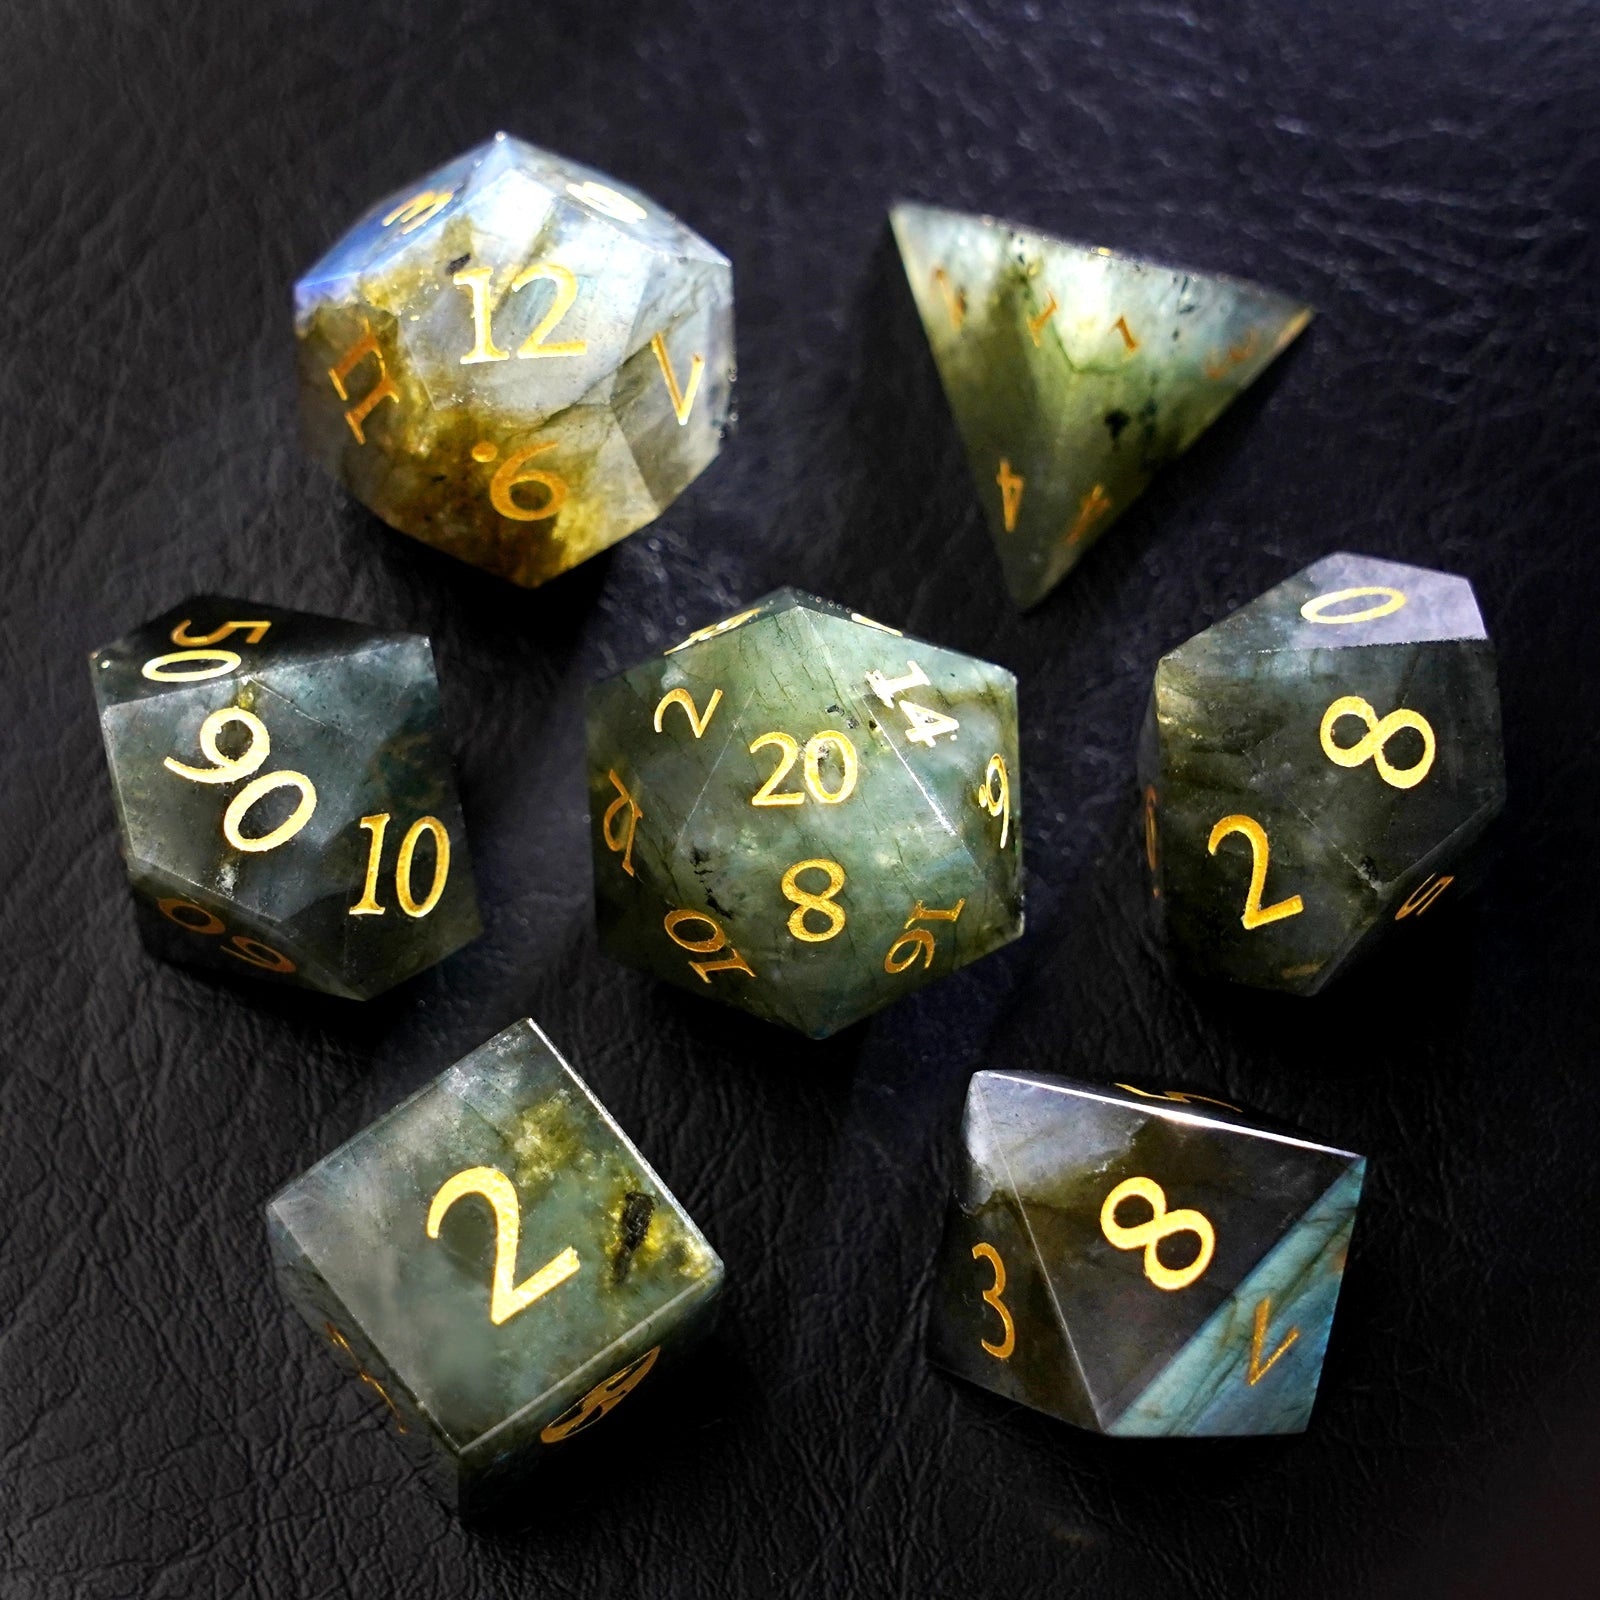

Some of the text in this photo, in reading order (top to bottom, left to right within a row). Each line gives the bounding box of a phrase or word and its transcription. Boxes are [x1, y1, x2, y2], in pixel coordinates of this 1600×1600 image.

[453, 264, 588, 364] 12
[1300, 586, 1407, 625] 0
[653, 688, 724, 738] 2
[1319, 695, 1436, 789] 8
[163, 706, 317, 853] 90
[749, 729, 858, 807] 20
[348, 812, 451, 918] 10
[781, 858, 846, 943] 8
[1207, 814, 1304, 930] 2
[426, 1166, 581, 1325] 2
[1099, 1176, 1216, 1290] 8
[971, 1242, 1015, 1359] 3
